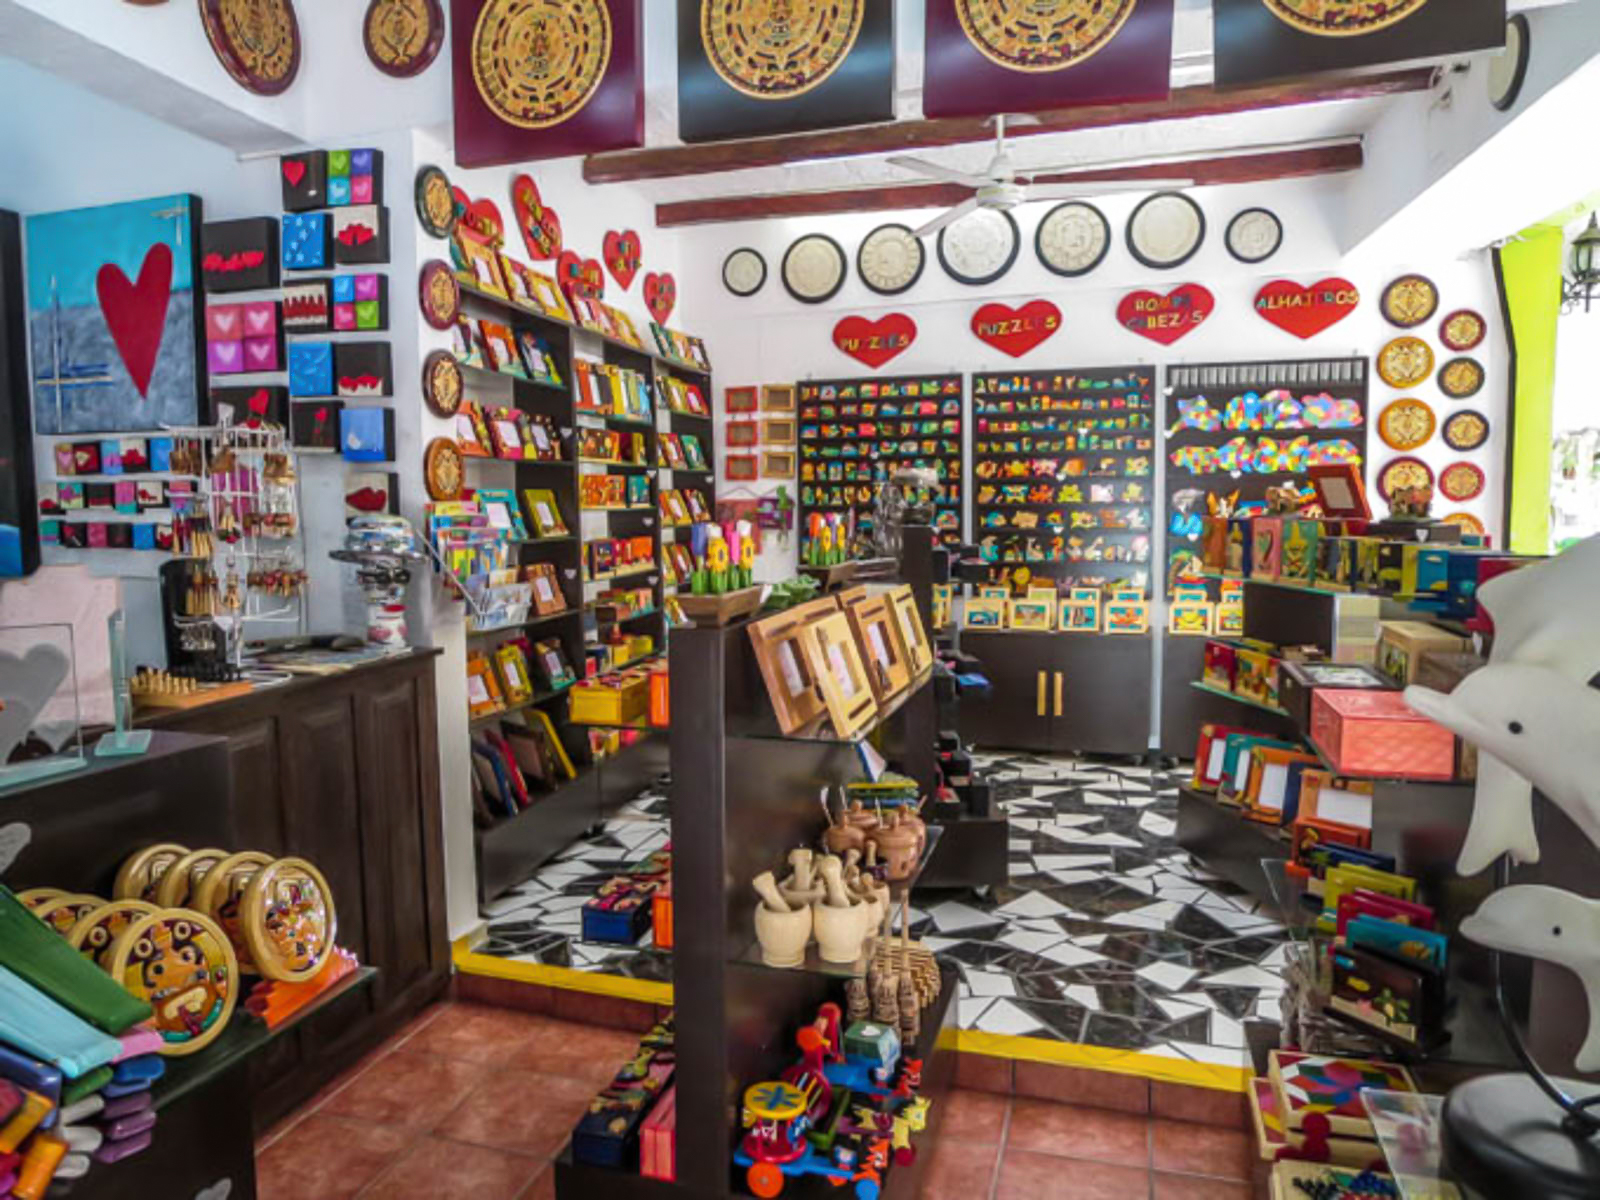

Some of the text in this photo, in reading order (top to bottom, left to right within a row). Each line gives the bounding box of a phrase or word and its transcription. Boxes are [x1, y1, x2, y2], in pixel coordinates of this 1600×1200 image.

[1256, 291, 1359, 309] ALHAJROS
[978, 316, 1056, 336] PUZZLS
[841, 333, 909, 351] PUZLS
